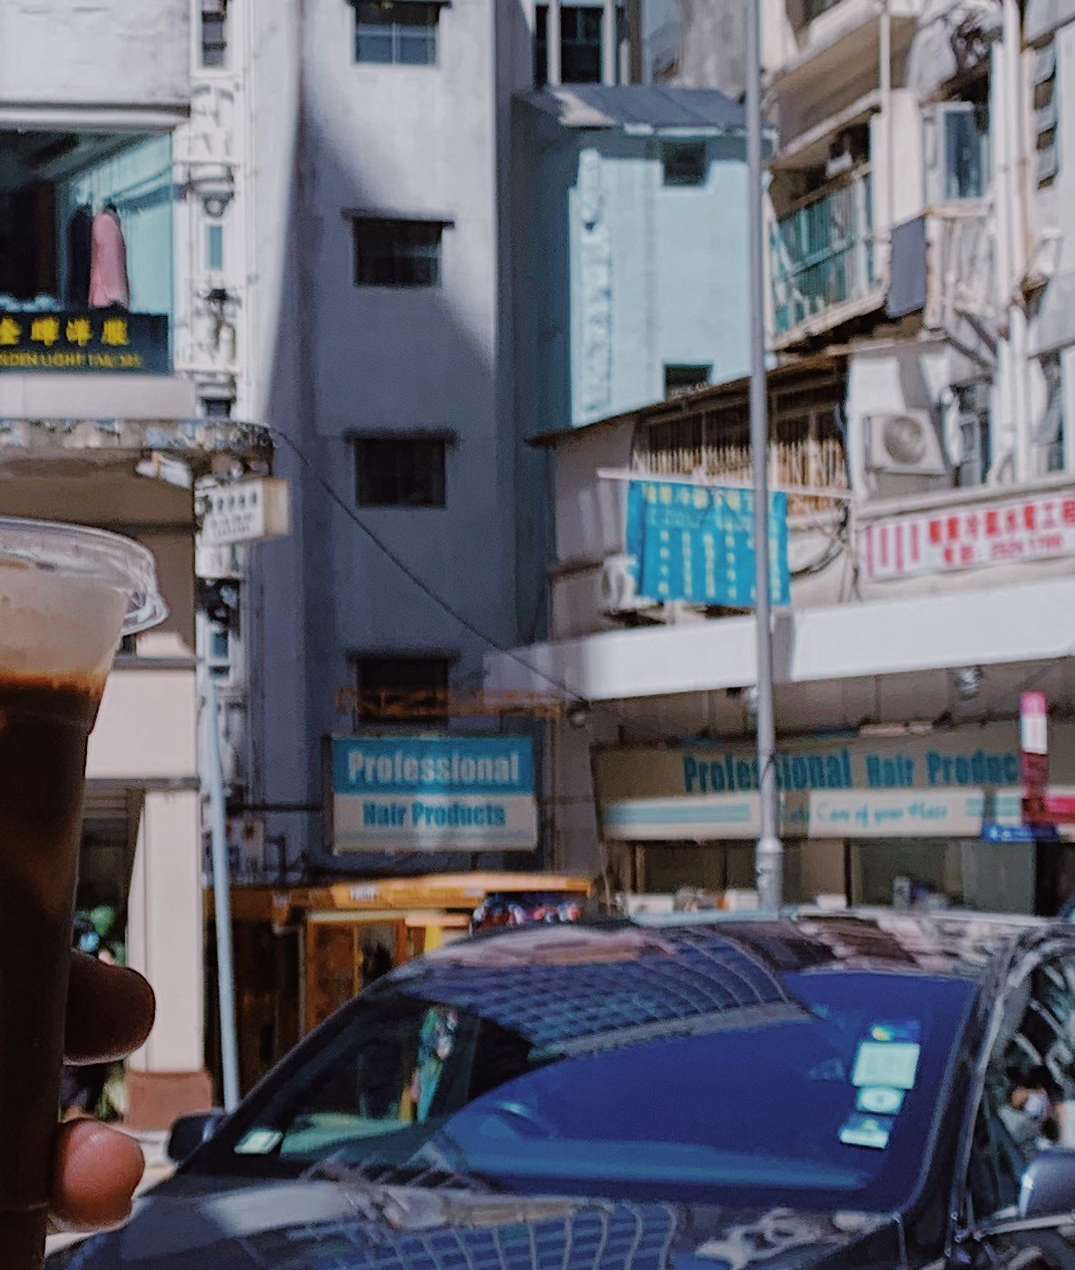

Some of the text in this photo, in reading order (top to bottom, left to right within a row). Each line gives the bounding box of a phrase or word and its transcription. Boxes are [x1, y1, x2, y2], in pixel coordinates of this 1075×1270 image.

[348, 749, 519, 784] Professional
[866, 751, 915, 787] Hair
[926, 747, 1020, 786] Produc
[362, 800, 506, 826] Hair Products
